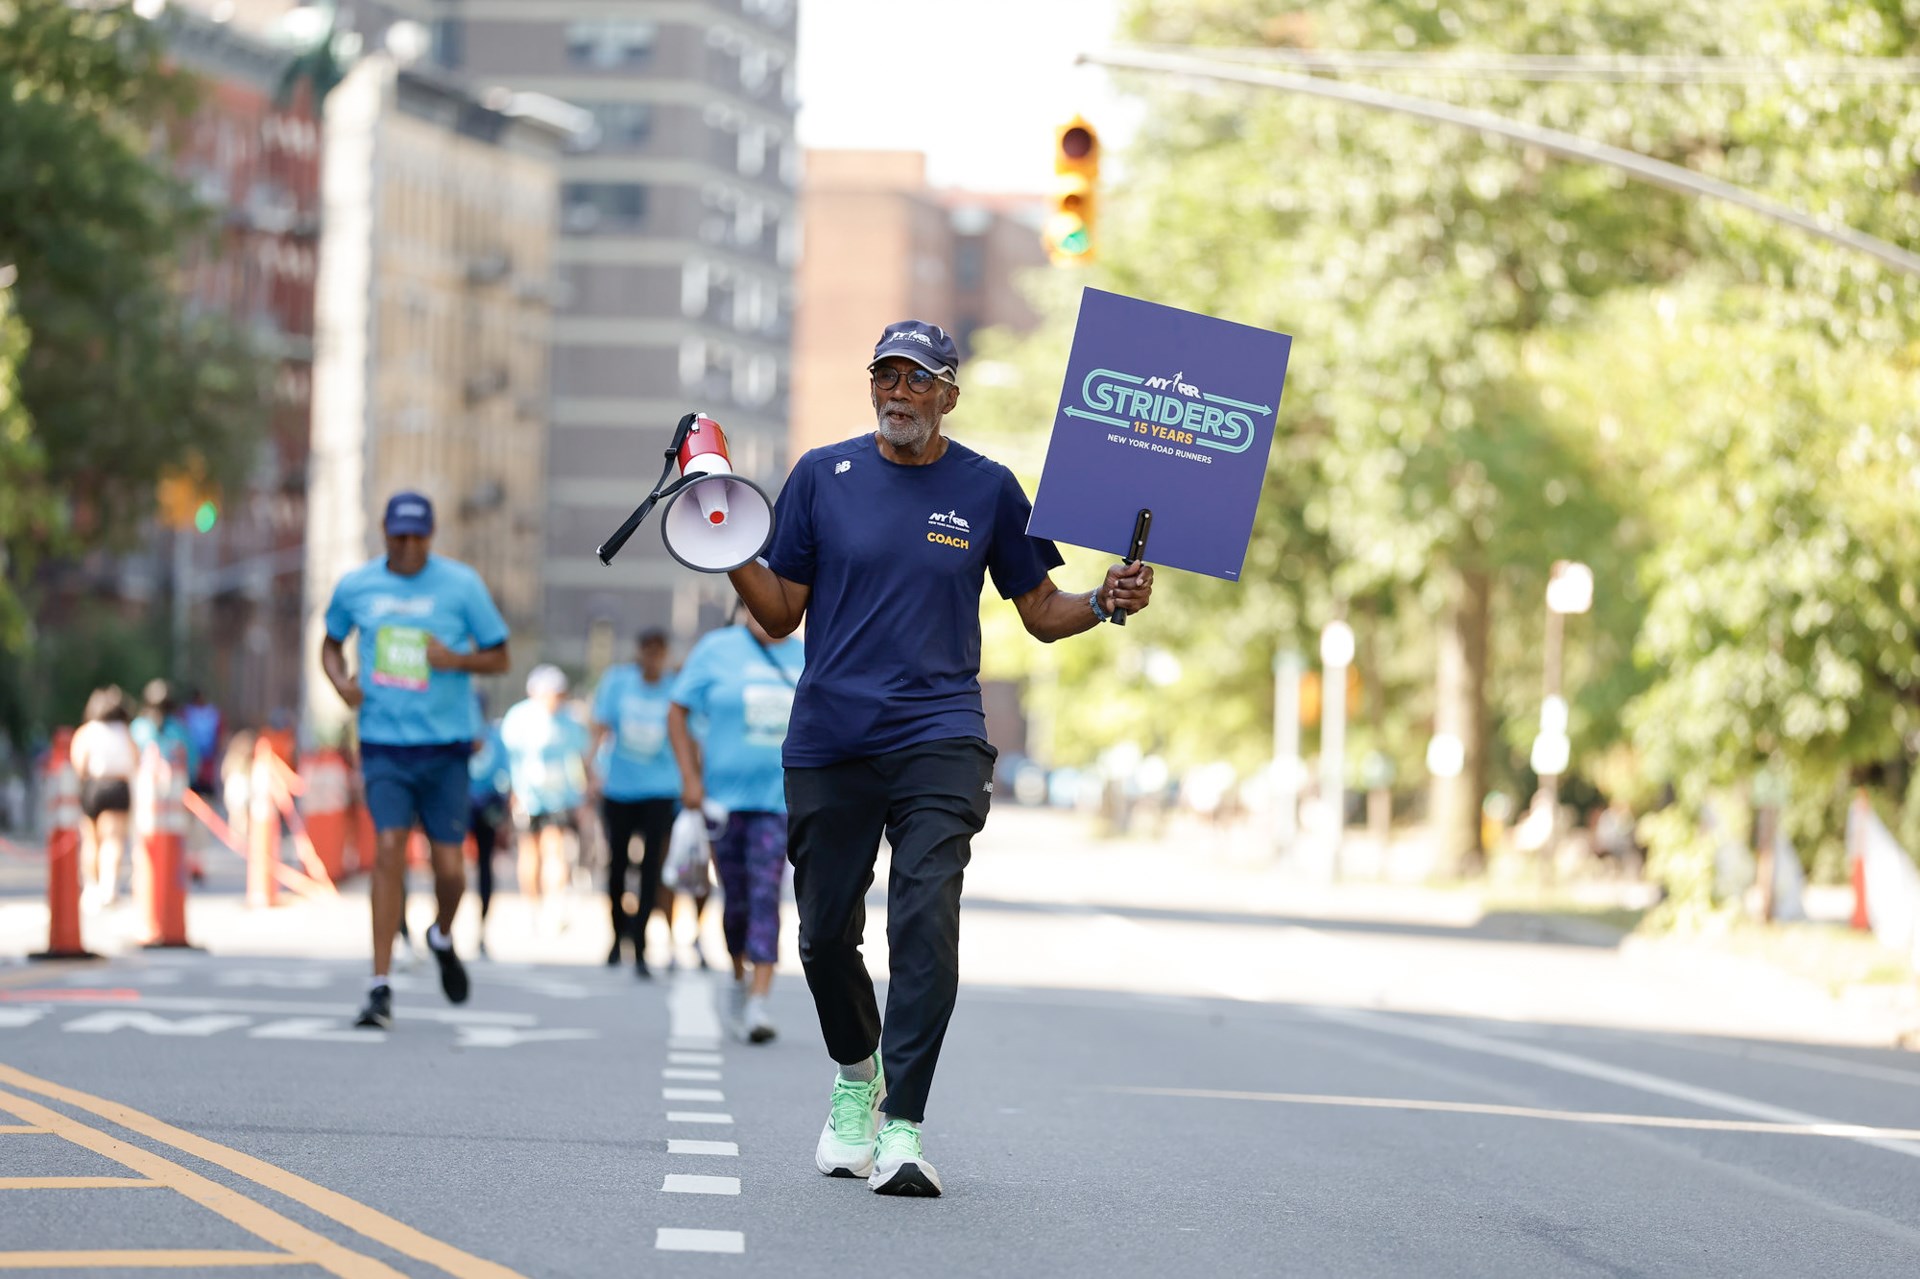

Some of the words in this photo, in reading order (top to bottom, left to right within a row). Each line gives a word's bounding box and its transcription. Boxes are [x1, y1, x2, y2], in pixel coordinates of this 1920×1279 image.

[1096, 382, 1243, 440] STRIDERS
[1133, 421, 1148, 434] 15
[1151, 425, 1194, 445] YEARS
[1107, 433, 1127, 444] NEW
[1128, 438, 1150, 450] YORK
[1151, 444, 1174, 455] ROAD
[1175, 449, 1213, 464] RUNNERS
[835, 460, 851, 475] NB
[927, 532, 969, 550] COACH
